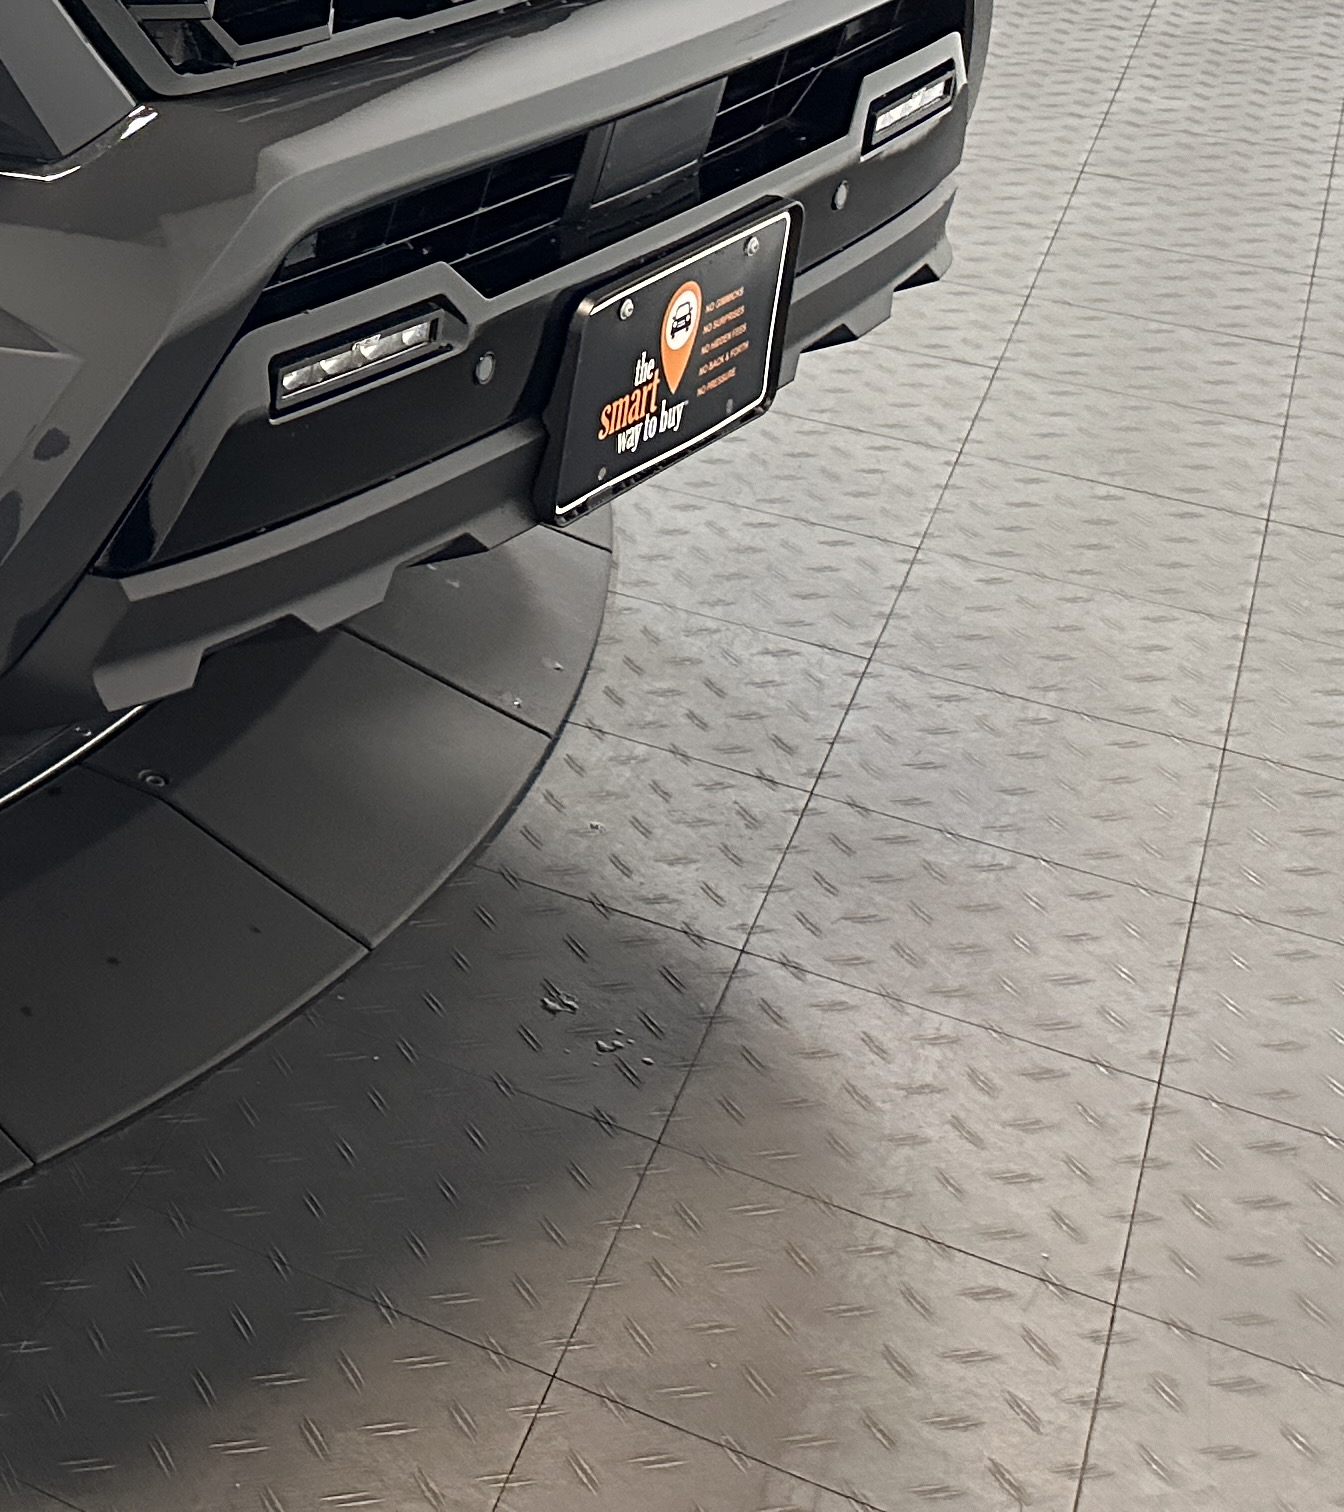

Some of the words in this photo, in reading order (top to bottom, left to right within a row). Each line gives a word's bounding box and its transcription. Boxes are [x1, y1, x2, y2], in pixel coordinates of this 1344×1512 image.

[634, 351, 655, 387] the
[597, 368, 661, 440] smart
[616, 422, 644, 454] way
[642, 413, 658, 442] to
[658, 399, 686, 432] buy
